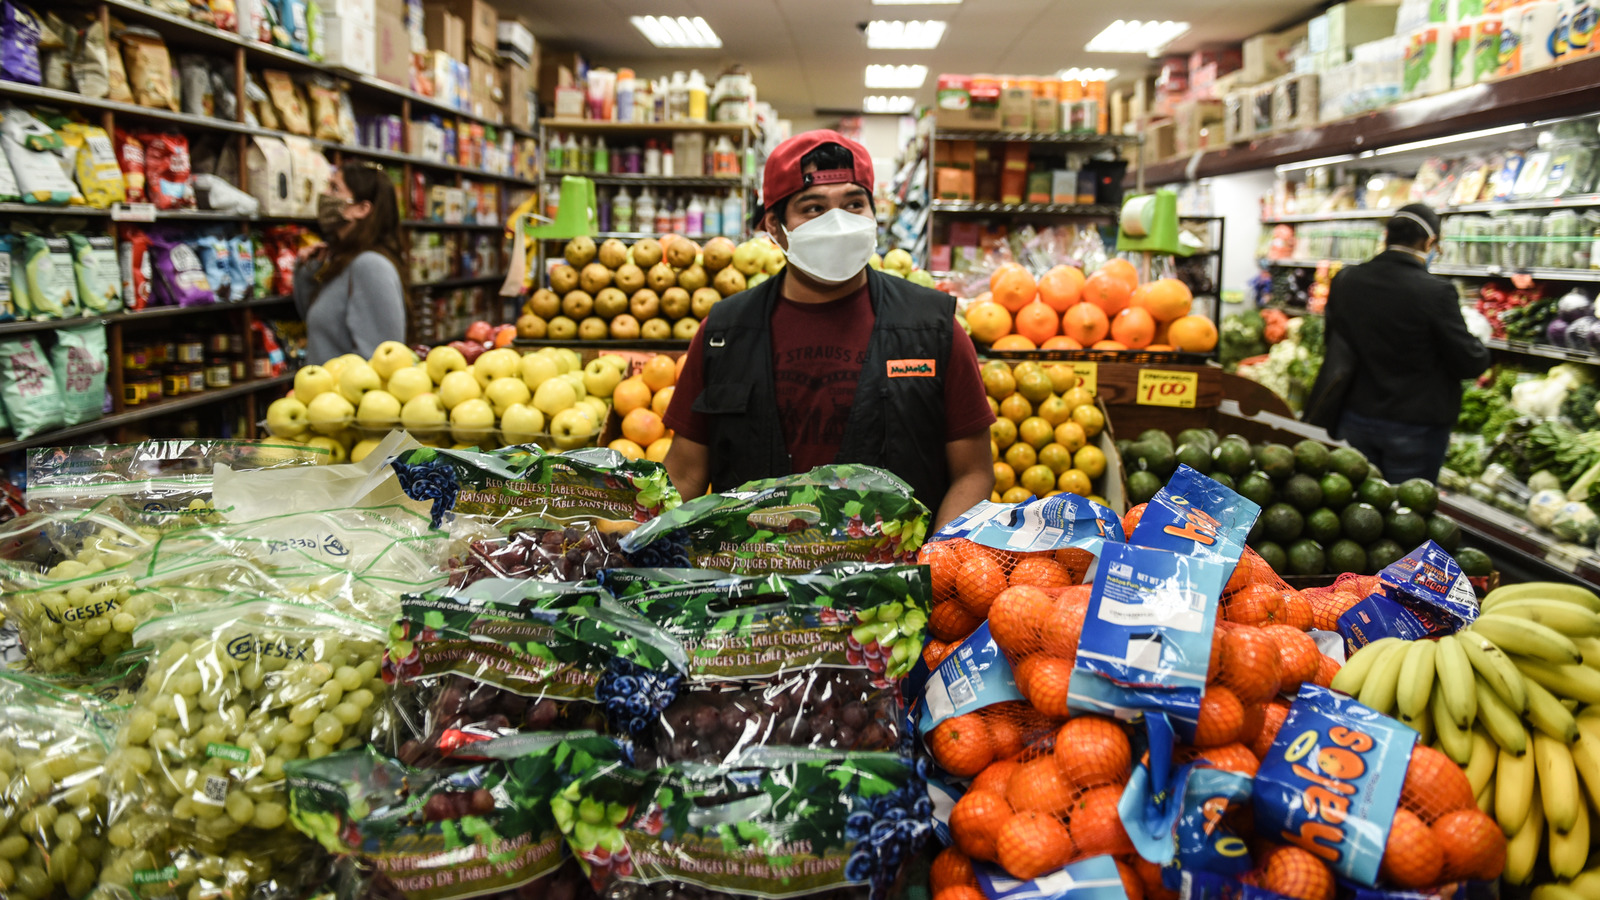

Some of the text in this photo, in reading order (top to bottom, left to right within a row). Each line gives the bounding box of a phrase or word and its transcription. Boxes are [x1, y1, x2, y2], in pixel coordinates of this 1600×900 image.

[786, 346, 851, 363] STRAUSS
[485, 477, 609, 499] RED SEEDLESS TABLE GRAPES
[460, 489, 497, 504] RAISINS
[499, 493, 533, 507] ROUGES
[535, 497, 549, 506] DE
[551, 497, 576, 508] TABLE
[578, 500, 601, 509] SANS
[720, 541, 847, 555] RED SEEDLESS TABLE GRAPES
[733, 557, 768, 569] ROUGES
[770, 558, 784, 569] DE
[786, 558, 811, 570] TABLE
[813, 558, 836, 571] SANS
[64, 599, 117, 623] GESEX
[507, 611, 526, 619] CHILE
[249, 639, 309, 662] GESEX
[700, 637, 747, 652] SEEDLESS
[750, 634, 779, 646] TABLE
[782, 632, 821, 645] GRAPES
[424, 650, 460, 664] RAISIN
[460, 651, 496, 668] OUGES
[496, 659, 512, 674] DE
[693, 655, 734, 668] ROUGES
[736, 654, 752, 666] DE
[755, 651, 782, 664] TABLE
[785, 649, 810, 660] SANS
[1281, 725, 1374, 863] halos
[436, 871, 454, 887] DE
[458, 864, 492, 883] TABLE
[726, 860, 740, 876] DE
